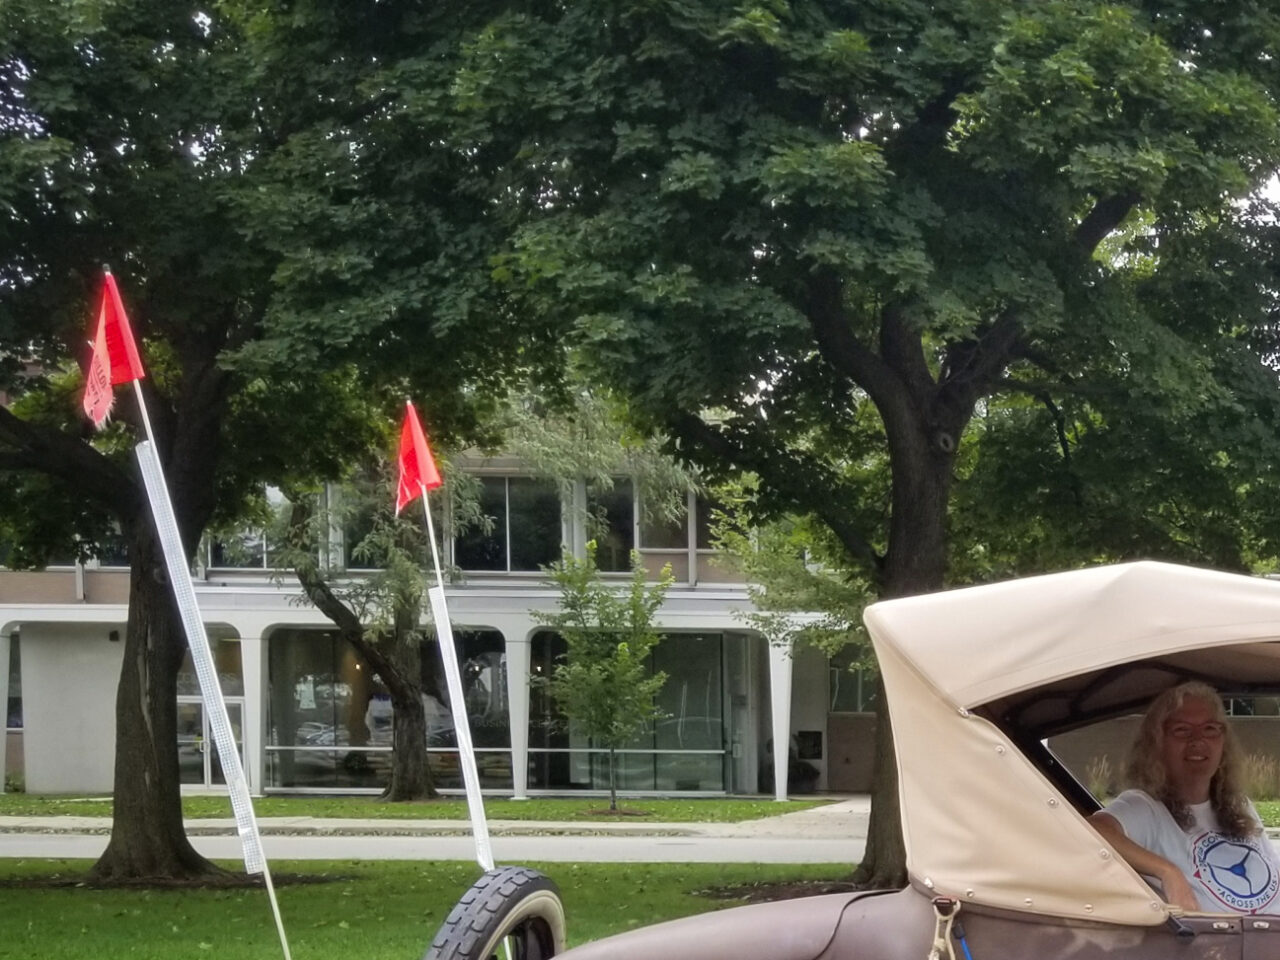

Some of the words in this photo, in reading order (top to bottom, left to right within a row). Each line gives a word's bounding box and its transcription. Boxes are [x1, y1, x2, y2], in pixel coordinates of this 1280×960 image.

[1219, 891, 1254, 908] ACROSS
[1256, 894, 1271, 906] THE
[1269, 880, 1278, 892] US
